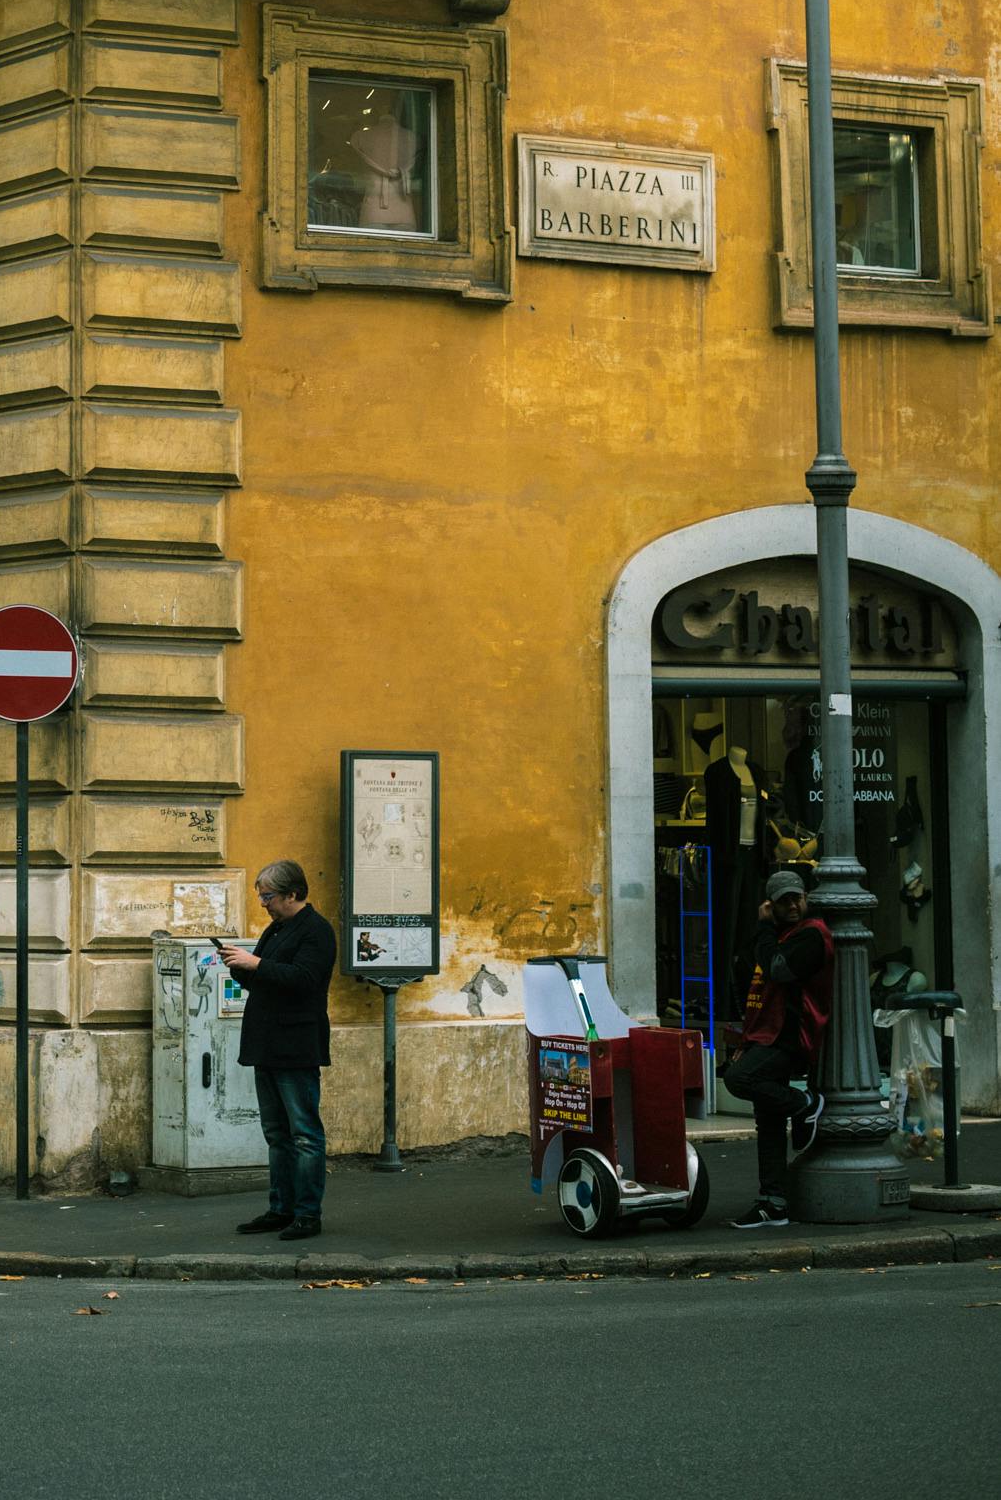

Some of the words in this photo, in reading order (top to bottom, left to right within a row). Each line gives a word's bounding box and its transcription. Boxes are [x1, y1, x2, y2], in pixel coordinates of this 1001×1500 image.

[575, 165, 664, 196] PIAZZA
[540, 208, 698, 244] BARBERINI
[857, 702, 890, 719] Klein
[852, 748, 885, 768] OLO
[861, 772, 893, 782] LAUREN
[541, 1040, 552, 1048] BUY
[553, 1041, 576, 1051] TICKETS
[575, 1043, 590, 1053] HERE
[548, 1090, 560, 1099] Enjoy
[560, 1092, 573, 1100] Rome
[544, 1097, 555, 1108] Hop
[556, 1099, 564, 1107] On
[567, 1101, 578, 1111] Hop
[578, 1102, 587, 1110] Off
[543, 1108, 558, 1118] SKIP
[559, 1111, 573, 1120] THE
[573, 1113, 588, 1122] LINE
